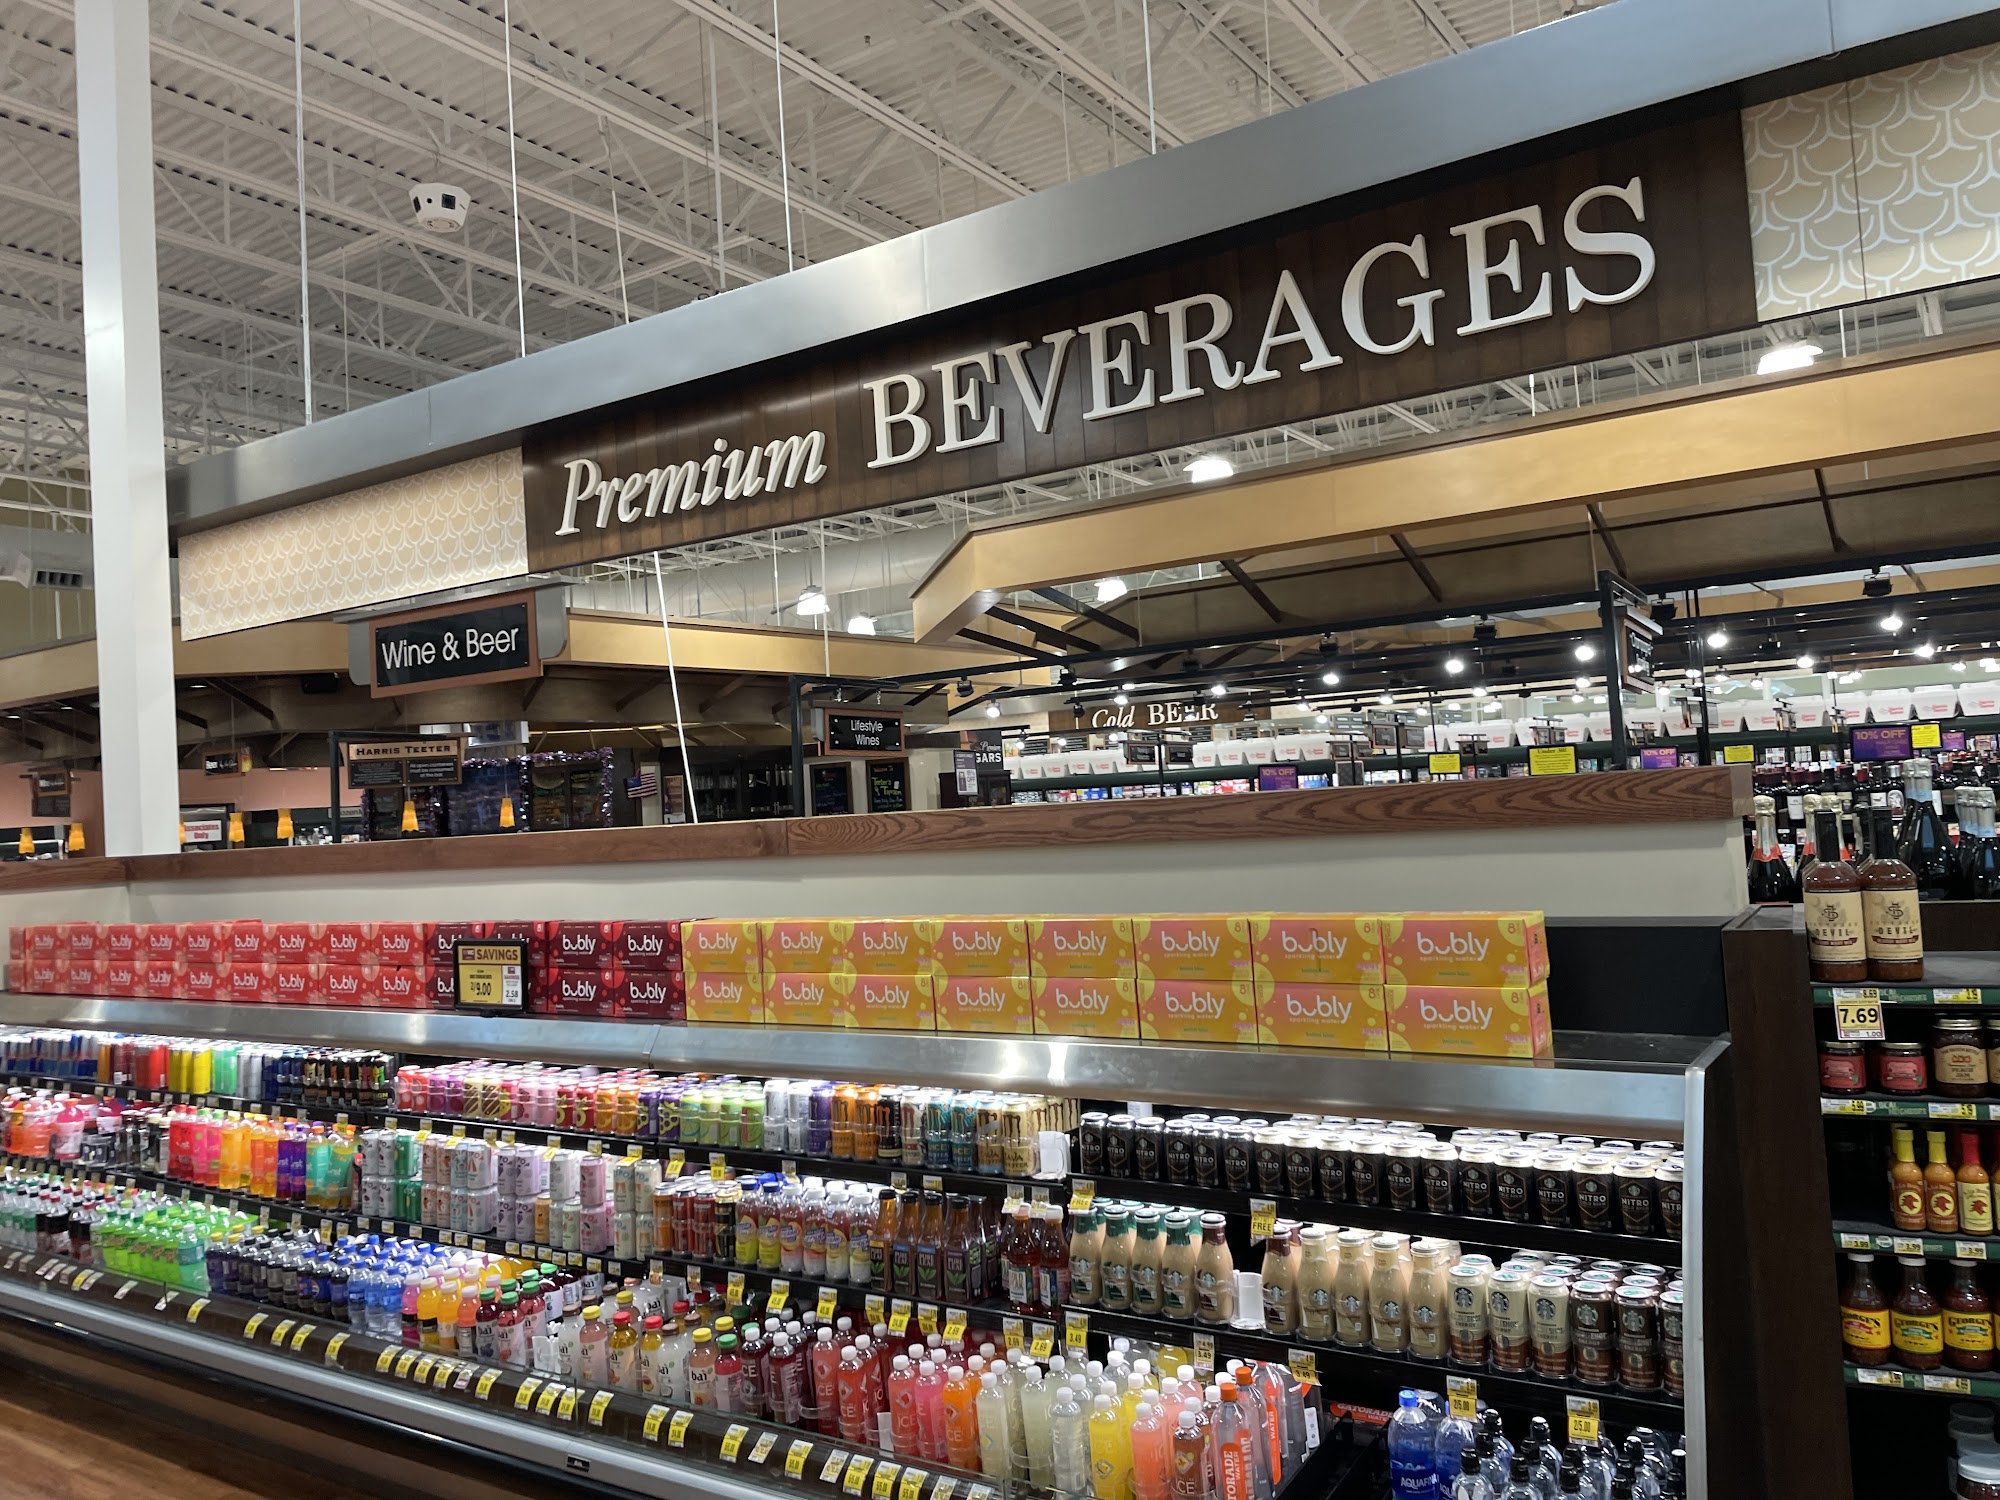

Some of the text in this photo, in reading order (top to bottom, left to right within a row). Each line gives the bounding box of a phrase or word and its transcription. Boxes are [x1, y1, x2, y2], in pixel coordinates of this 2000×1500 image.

[555, 177, 1656, 536] Premium BEVERAGES
[381, 627, 519, 670] Wine & Beer
[1091, 706, 1135, 727] Cold
[851, 719, 883, 734] Lifestyle
[855, 734, 880, 746] Wines
[1855, 731, 1878, 740] 10%
[1880, 730, 1906, 739] OFF
[356, 745, 451, 756] HARRIS TEETER
[975, 752, 1002, 763] GARS
[331, 934, 357, 951] bubly
[382, 934, 410, 952] bubly
[562, 934, 596, 954] bubly
[628, 934, 663, 956] bubly
[698, 932, 737, 954] bubly
[781, 931, 823, 954] bubly
[862, 931, 908, 955] bubly
[952, 931, 1002, 956] bubly
[1053, 930, 1107, 956] bubly
[1161, 930, 1220, 957] bubly
[1281, 930, 1348, 959] bubly
[1416, 931, 1490, 961] bubly
[477, 948, 518, 960] SAVINGS
[329, 975, 358, 993] bubly
[382, 976, 411, 994] bubly
[470, 981, 492, 996] 2/9.00
[562, 980, 596, 1001] bubly
[505, 990, 518, 998] 2.58
[630, 982, 666, 1004] bubly
[703, 981, 743, 1003] bubly
[782, 982, 824, 1005] bubly
[864, 985, 909, 1008] bubly
[956, 987, 1006, 1012] bubly
[1055, 987, 1109, 1015] bubly
[1165, 991, 1225, 1019] bubly
[1286, 994, 1352, 1024] bubly
[1420, 998, 1493, 1030] bubly
[1839, 1008, 1878, 1024] 7.69
[1168, 1152, 1190, 1160] NITRO
[1225, 1158, 1247, 1167] NITRO
[1257, 1160, 1279, 1169] NITRO
[1287, 1165, 1310, 1173] NITRO
[1320, 1168, 1343, 1177] NITRO
[1352, 1170, 1372, 1180] NITRO
[1388, 1174, 1411, 1184] NITRO
[1424, 1178, 1448, 1187] NITRO
[1463, 1180, 1487, 1190] NITRO
[1498, 1185, 1524, 1195] NITRO
[1538, 1190, 1565, 1199] NITRO
[1578, 1194, 1607, 1203] NITRO
[1621, 1198, 1649, 1207] NITRO
[1662, 1202, 1682, 1211] NITR
[1253, 1222, 1272, 1232] FREE
[919, 1259, 934, 1267] LEAF
[948, 1257, 962, 1265] PURE
[948, 1263, 962, 1271] LEAF
[1894, 1318, 1939, 1331] GEORGE'S
[947, 1327, 959, 1336] 2.69
[1069, 1333, 1082, 1343] 3.49
[1034, 1341, 1047, 1352] 2.69
[1197, 1350, 1212, 1360] 3.49
[840, 1406, 854, 1417] CE
[1454, 1400, 1470, 1411] 2/5.00
[897, 1415, 916, 1427] ICE
[1574, 1419, 1590, 1432] 2/5.00
[947, 1430, 962, 1441] CE
[1224, 1451, 1237, 1500] TORADE
